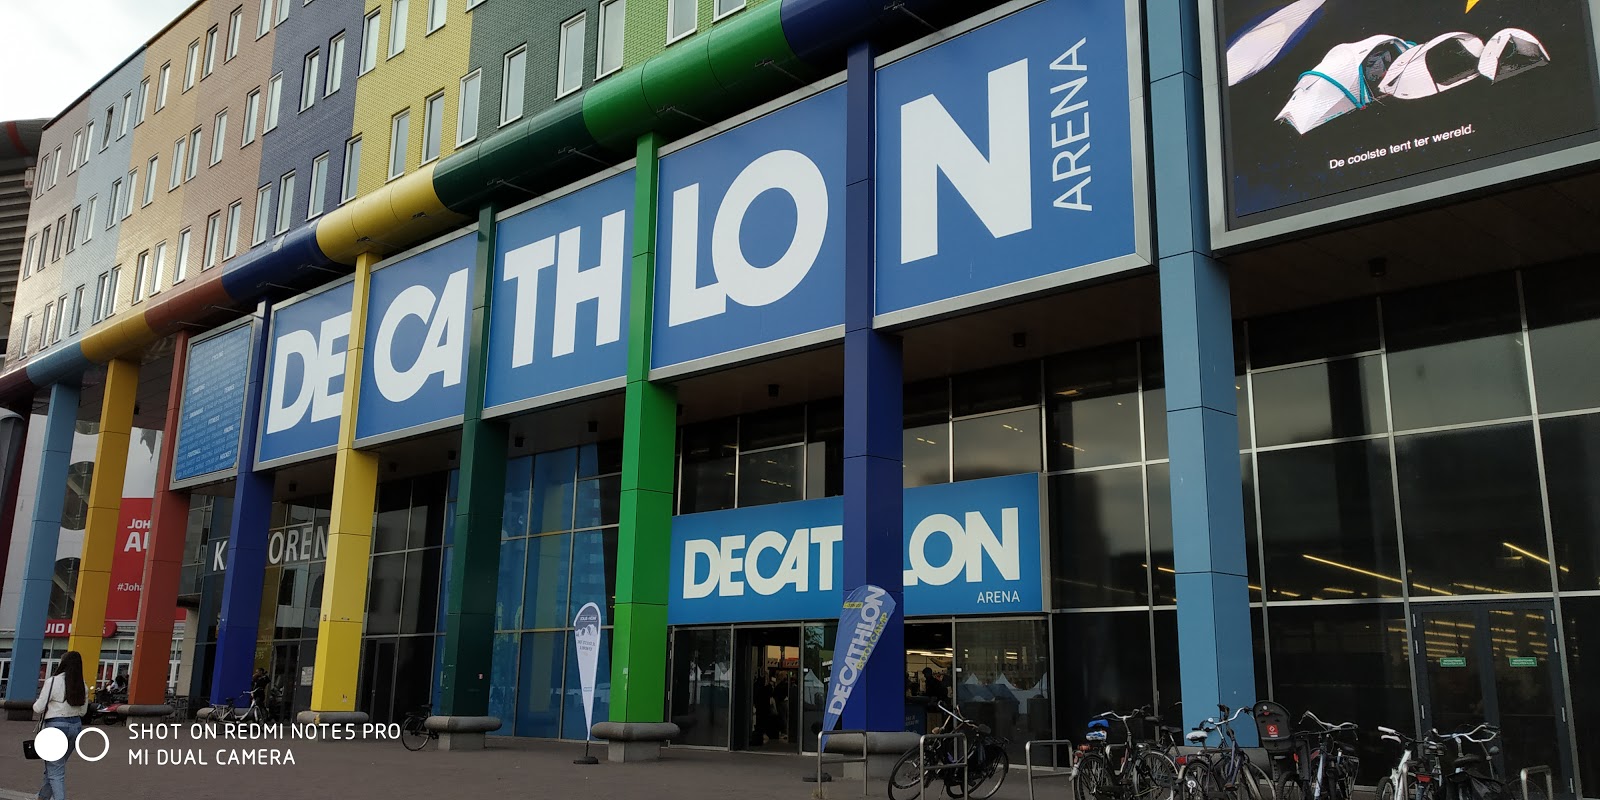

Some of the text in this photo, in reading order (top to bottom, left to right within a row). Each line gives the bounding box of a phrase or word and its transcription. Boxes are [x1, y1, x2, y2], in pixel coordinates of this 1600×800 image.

[1049, 36, 1093, 212] ARENA
[1329, 124, 1476, 170] De coolste tent ter wereld.
[127, 518, 151, 529] JOH
[683, 507, 1021, 599] DECATON
[977, 590, 1021, 604] ARENA
[828, 585, 886, 716] DECATHLON
[856, 612, 889, 671] BOOTCAMP
